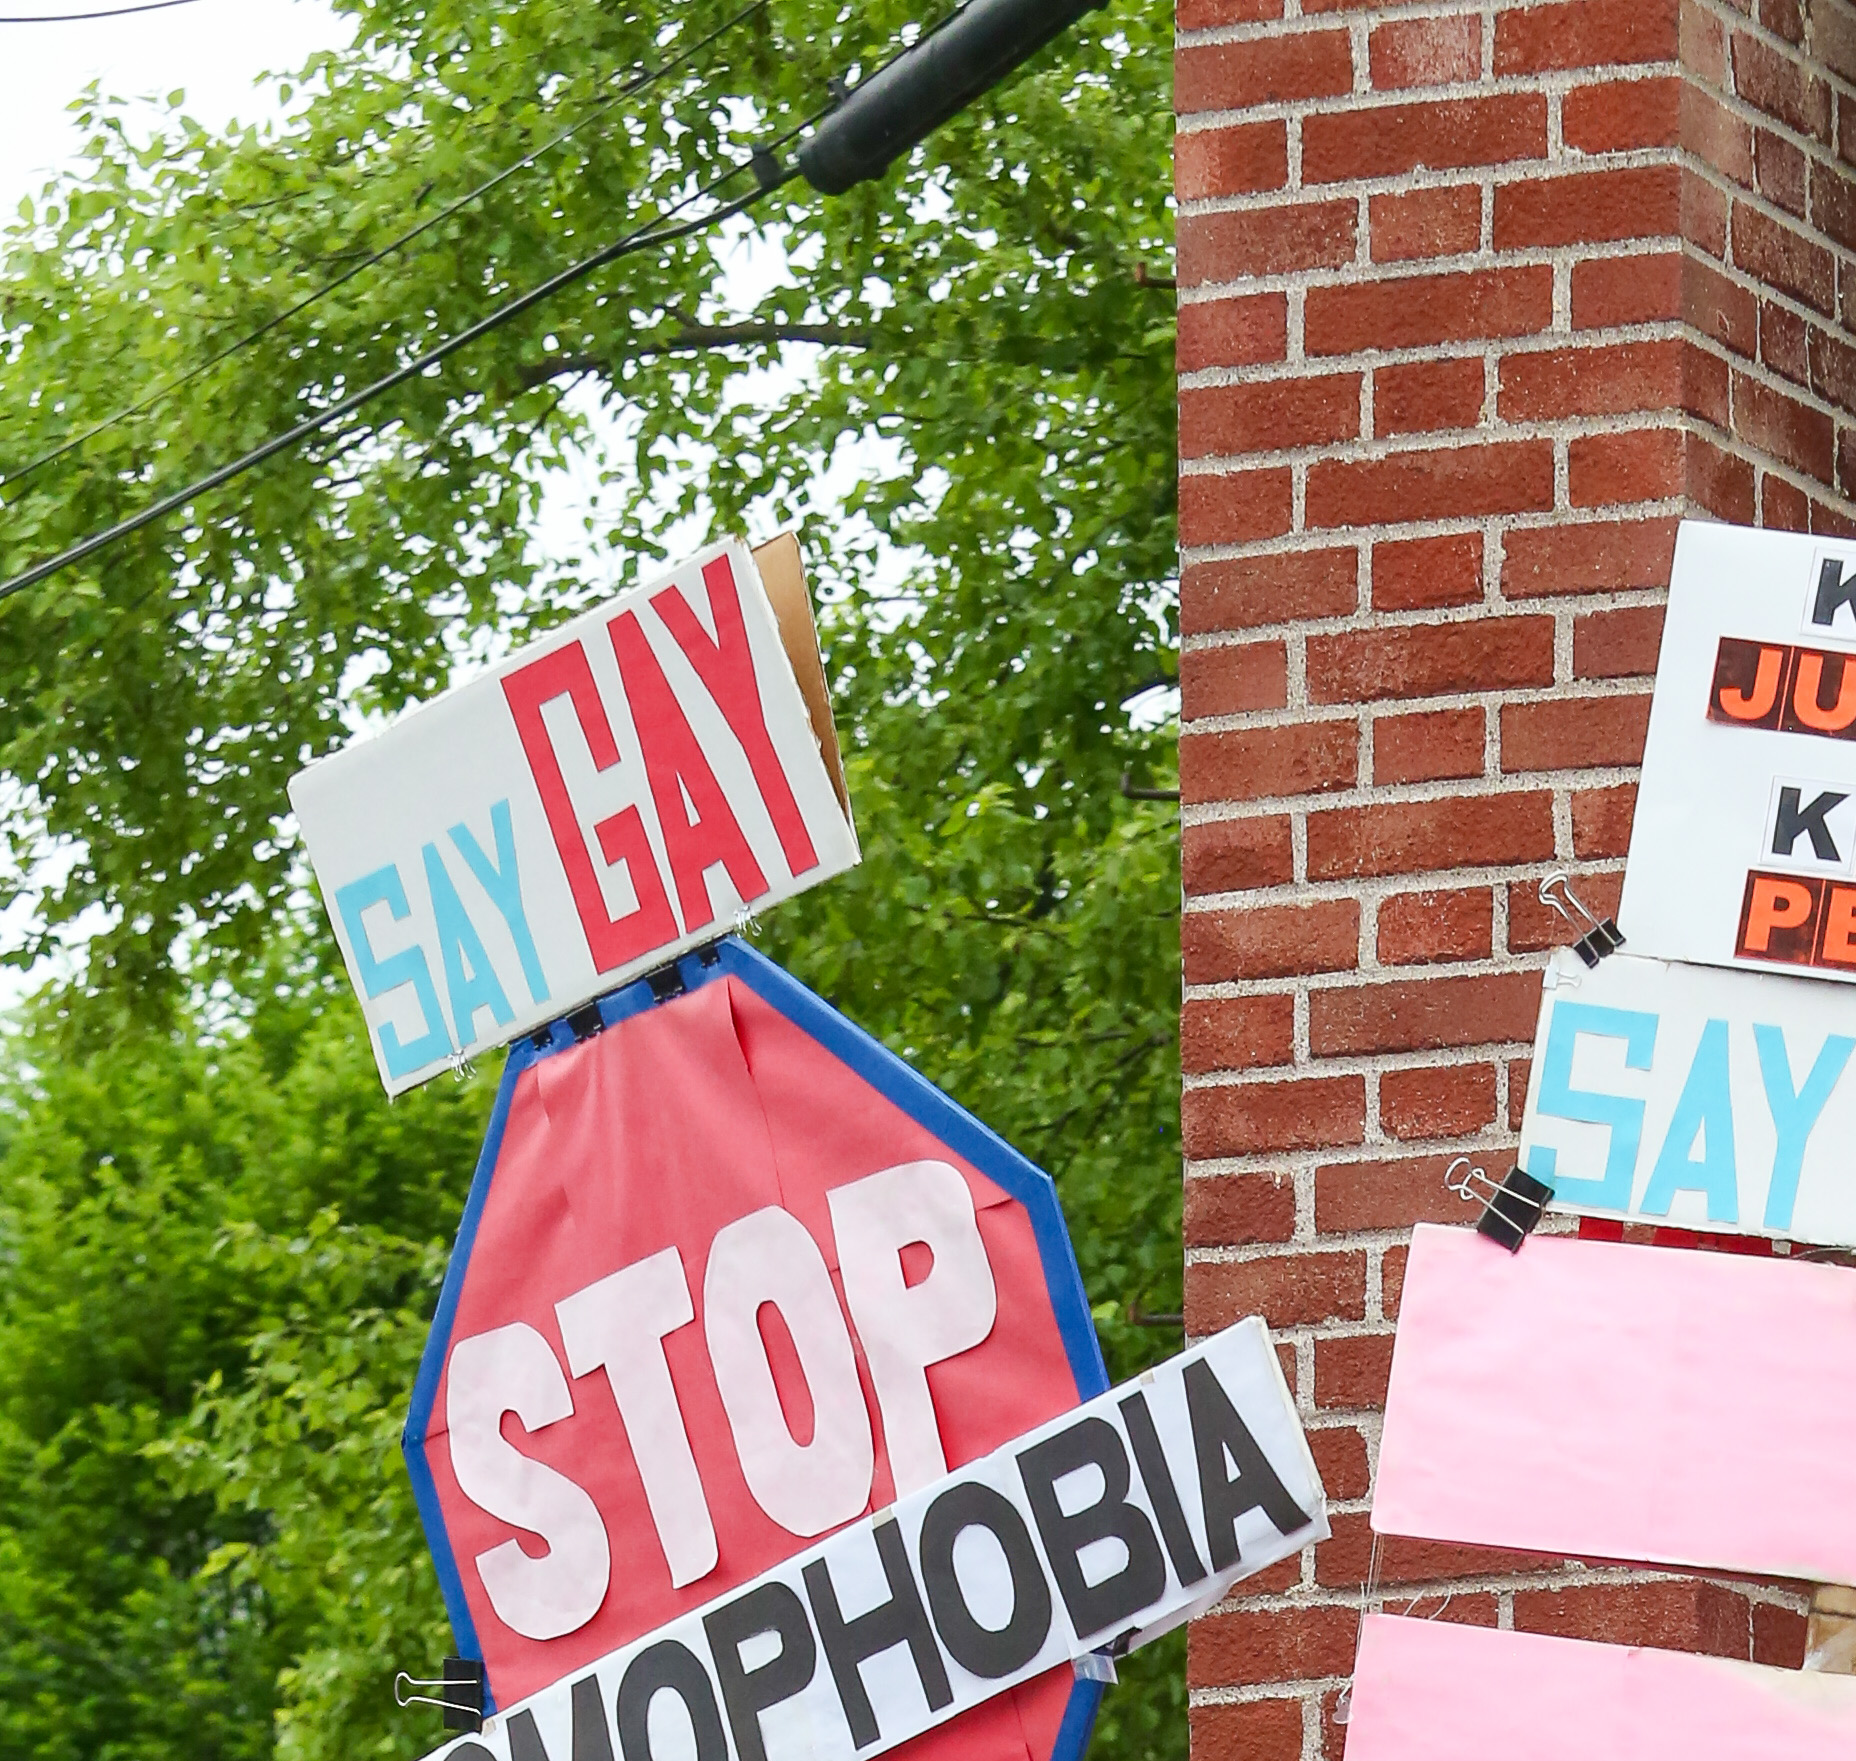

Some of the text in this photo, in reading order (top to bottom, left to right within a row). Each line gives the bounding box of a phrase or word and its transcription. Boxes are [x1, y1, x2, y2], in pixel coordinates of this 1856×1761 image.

[335, 554, 817, 1073] SAY GAY
[447, 1160, 997, 1641] STOP
